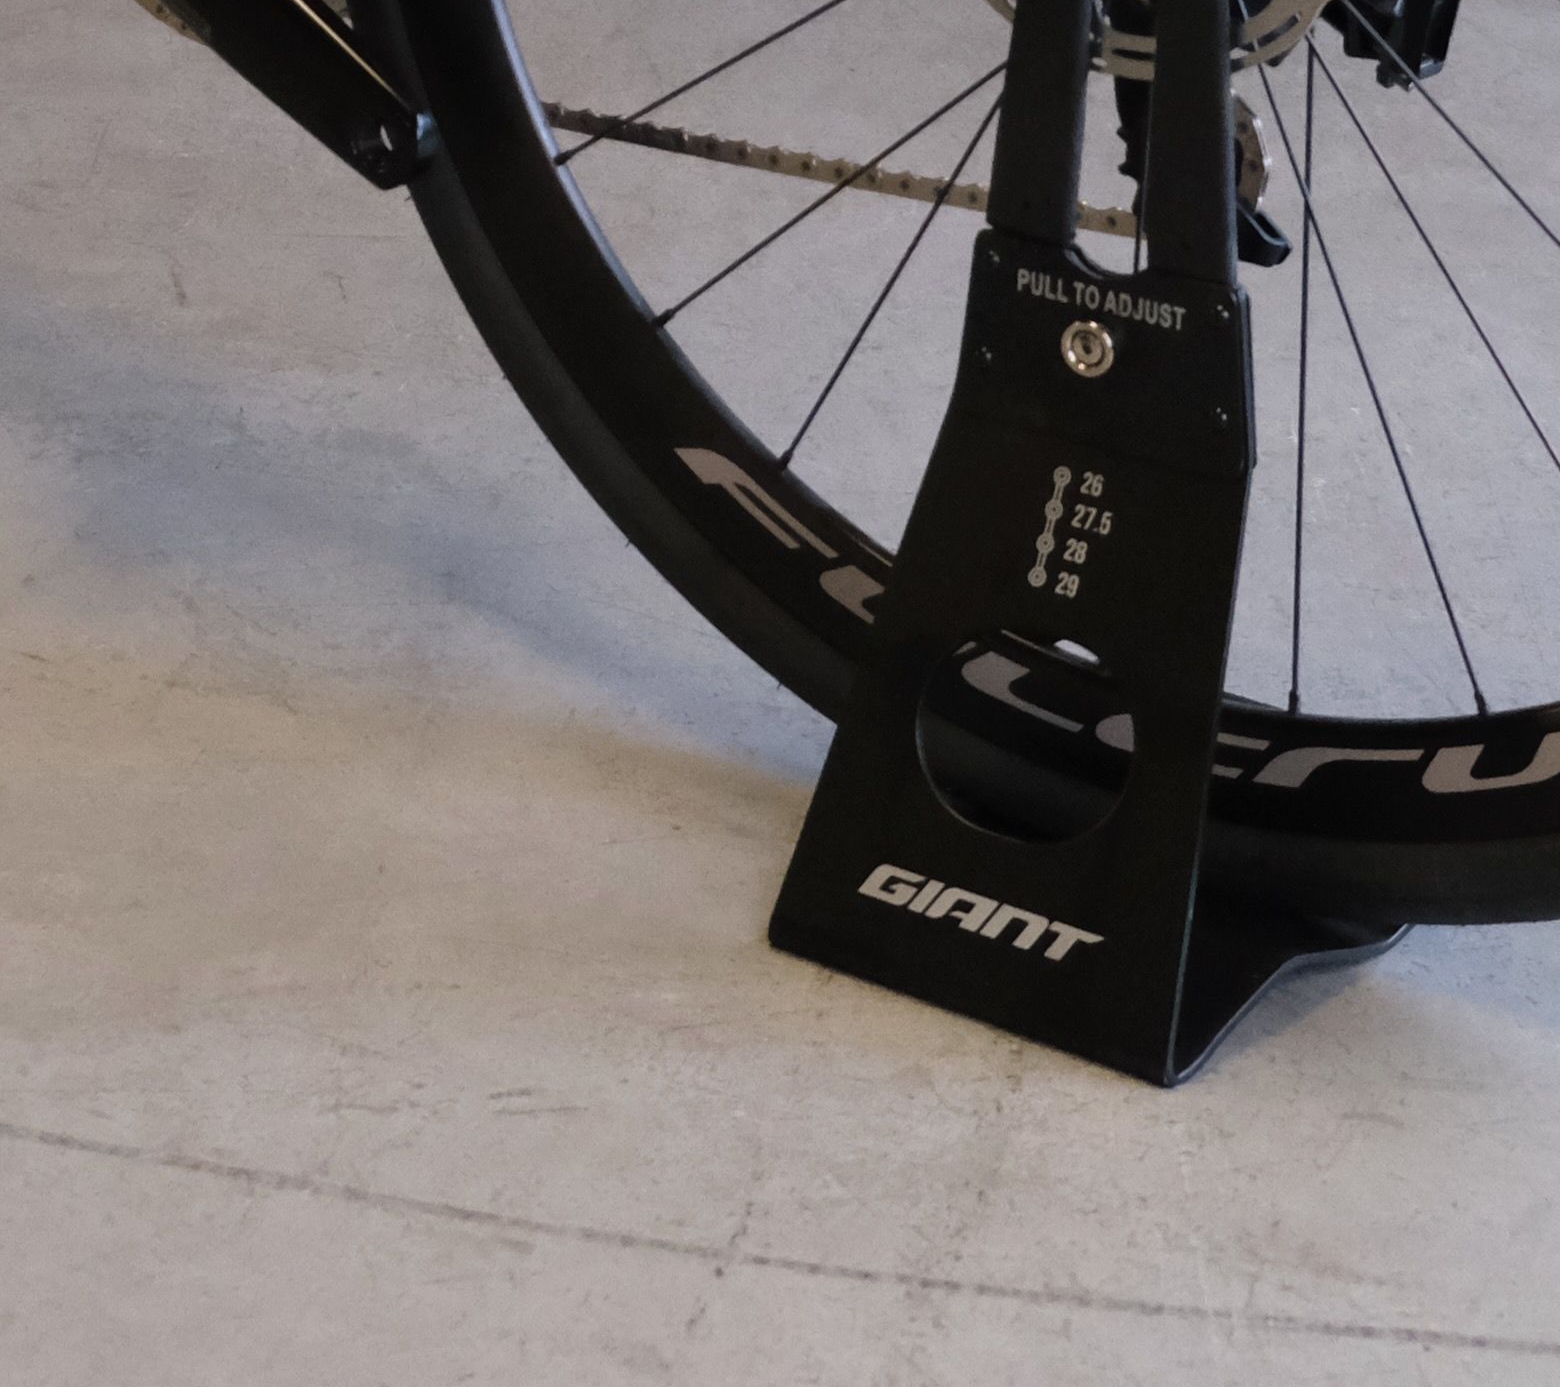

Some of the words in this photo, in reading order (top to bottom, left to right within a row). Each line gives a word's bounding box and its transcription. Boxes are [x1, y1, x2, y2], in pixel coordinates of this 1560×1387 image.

[1017, 269, 1068, 304] PULL
[1074, 283, 1101, 310] TO
[1104, 291, 1186, 330] ADJUST
[1080, 472, 1103, 497] 26
[1070, 505, 1112, 535] 27.5
[1063, 539, 1087, 563] 28
[1055, 573, 1079, 597] 29
[858, 863, 1104, 962] GIANT
